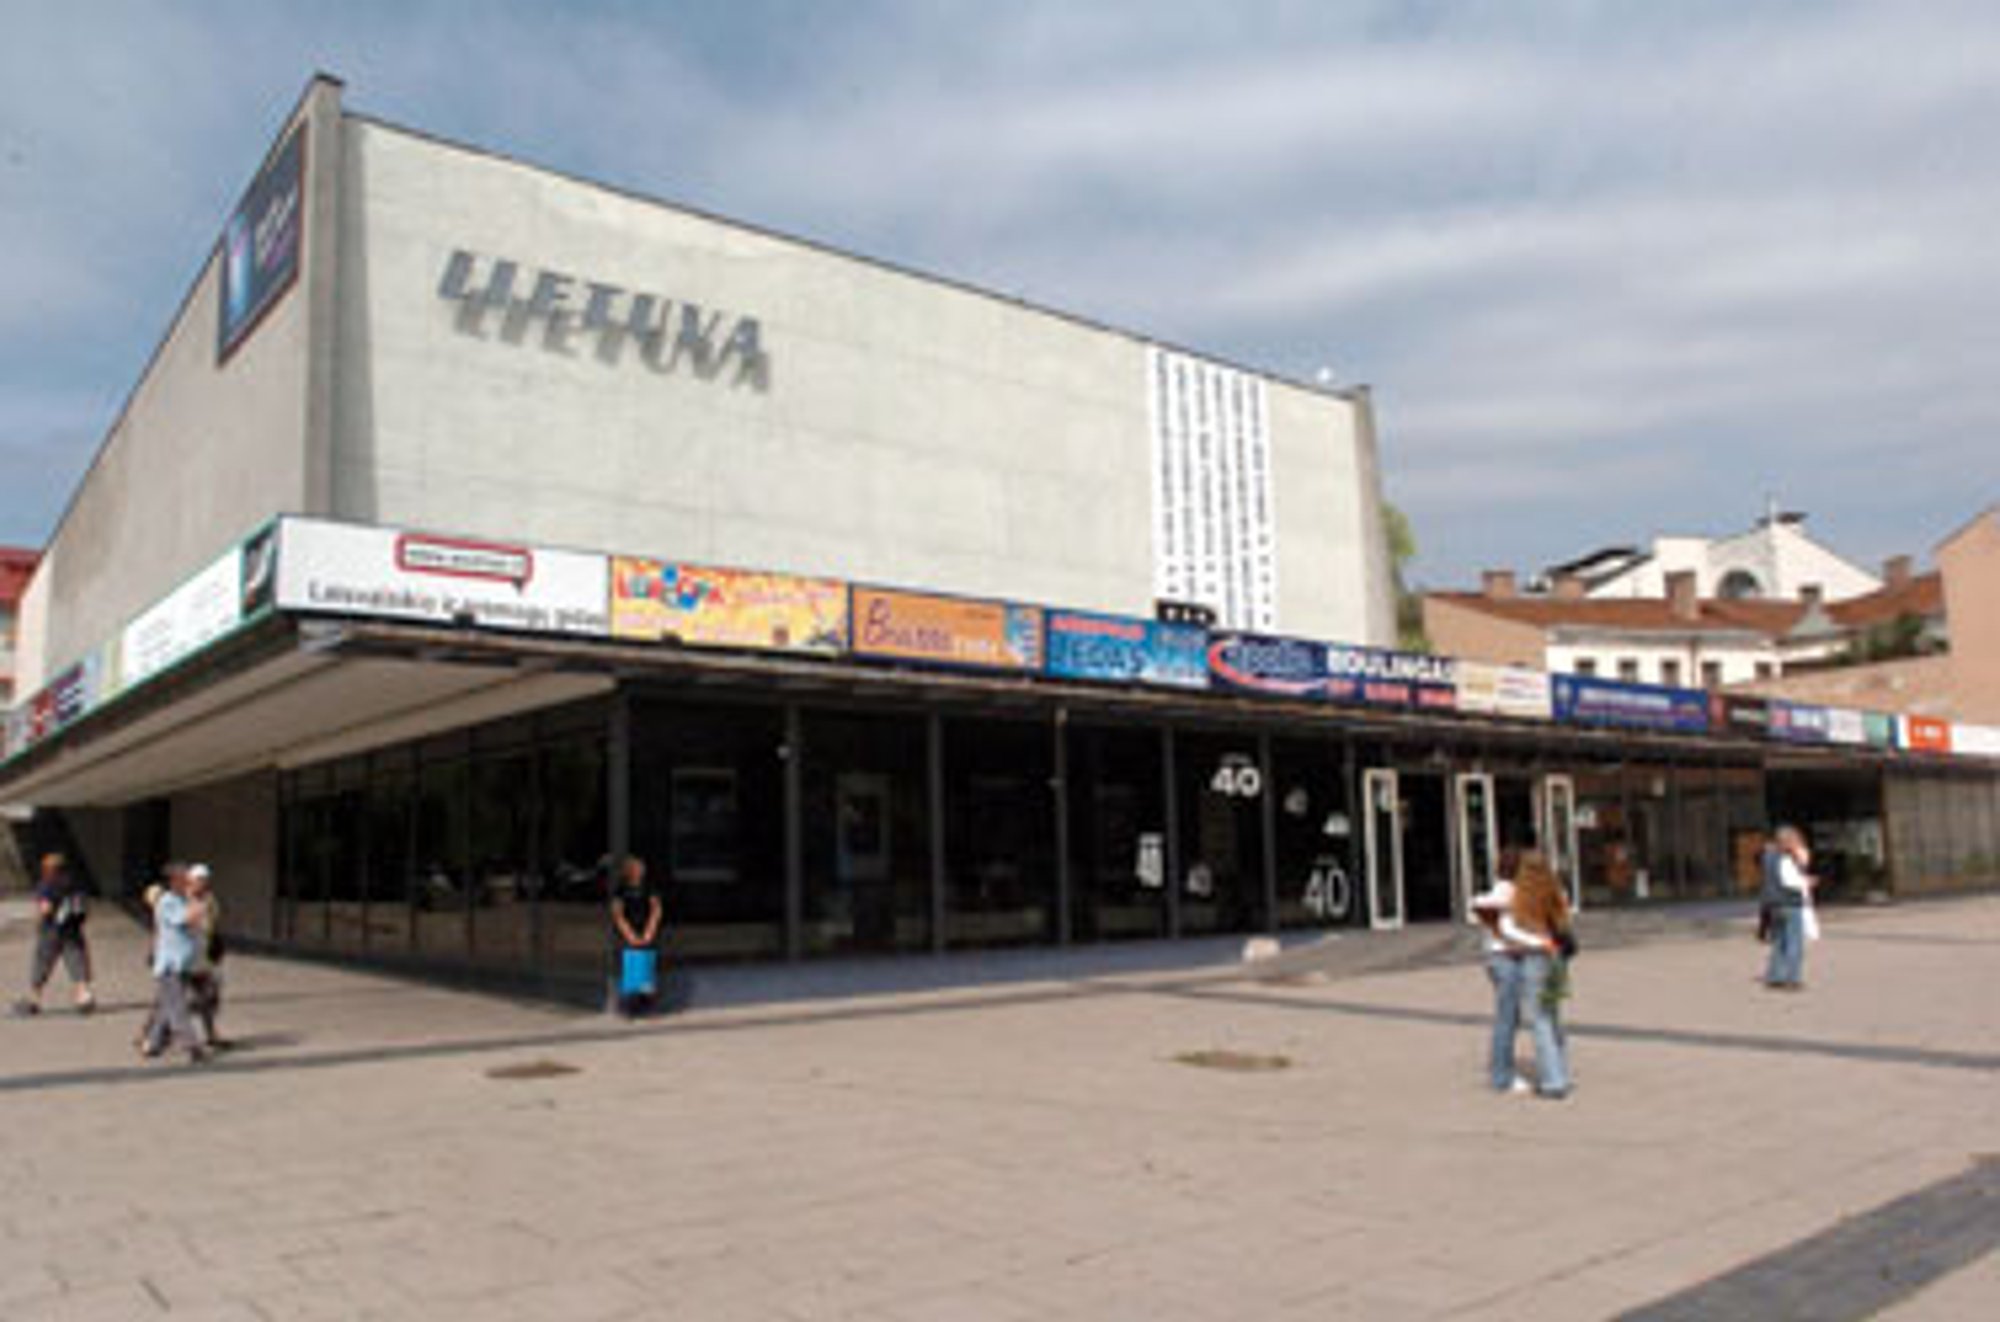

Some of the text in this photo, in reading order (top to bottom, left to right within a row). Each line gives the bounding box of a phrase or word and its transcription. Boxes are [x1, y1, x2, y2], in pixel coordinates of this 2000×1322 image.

[438, 249, 762, 357] LIETUVA
[1211, 767, 1260, 797] 40
[1303, 868, 1348, 918] 40
